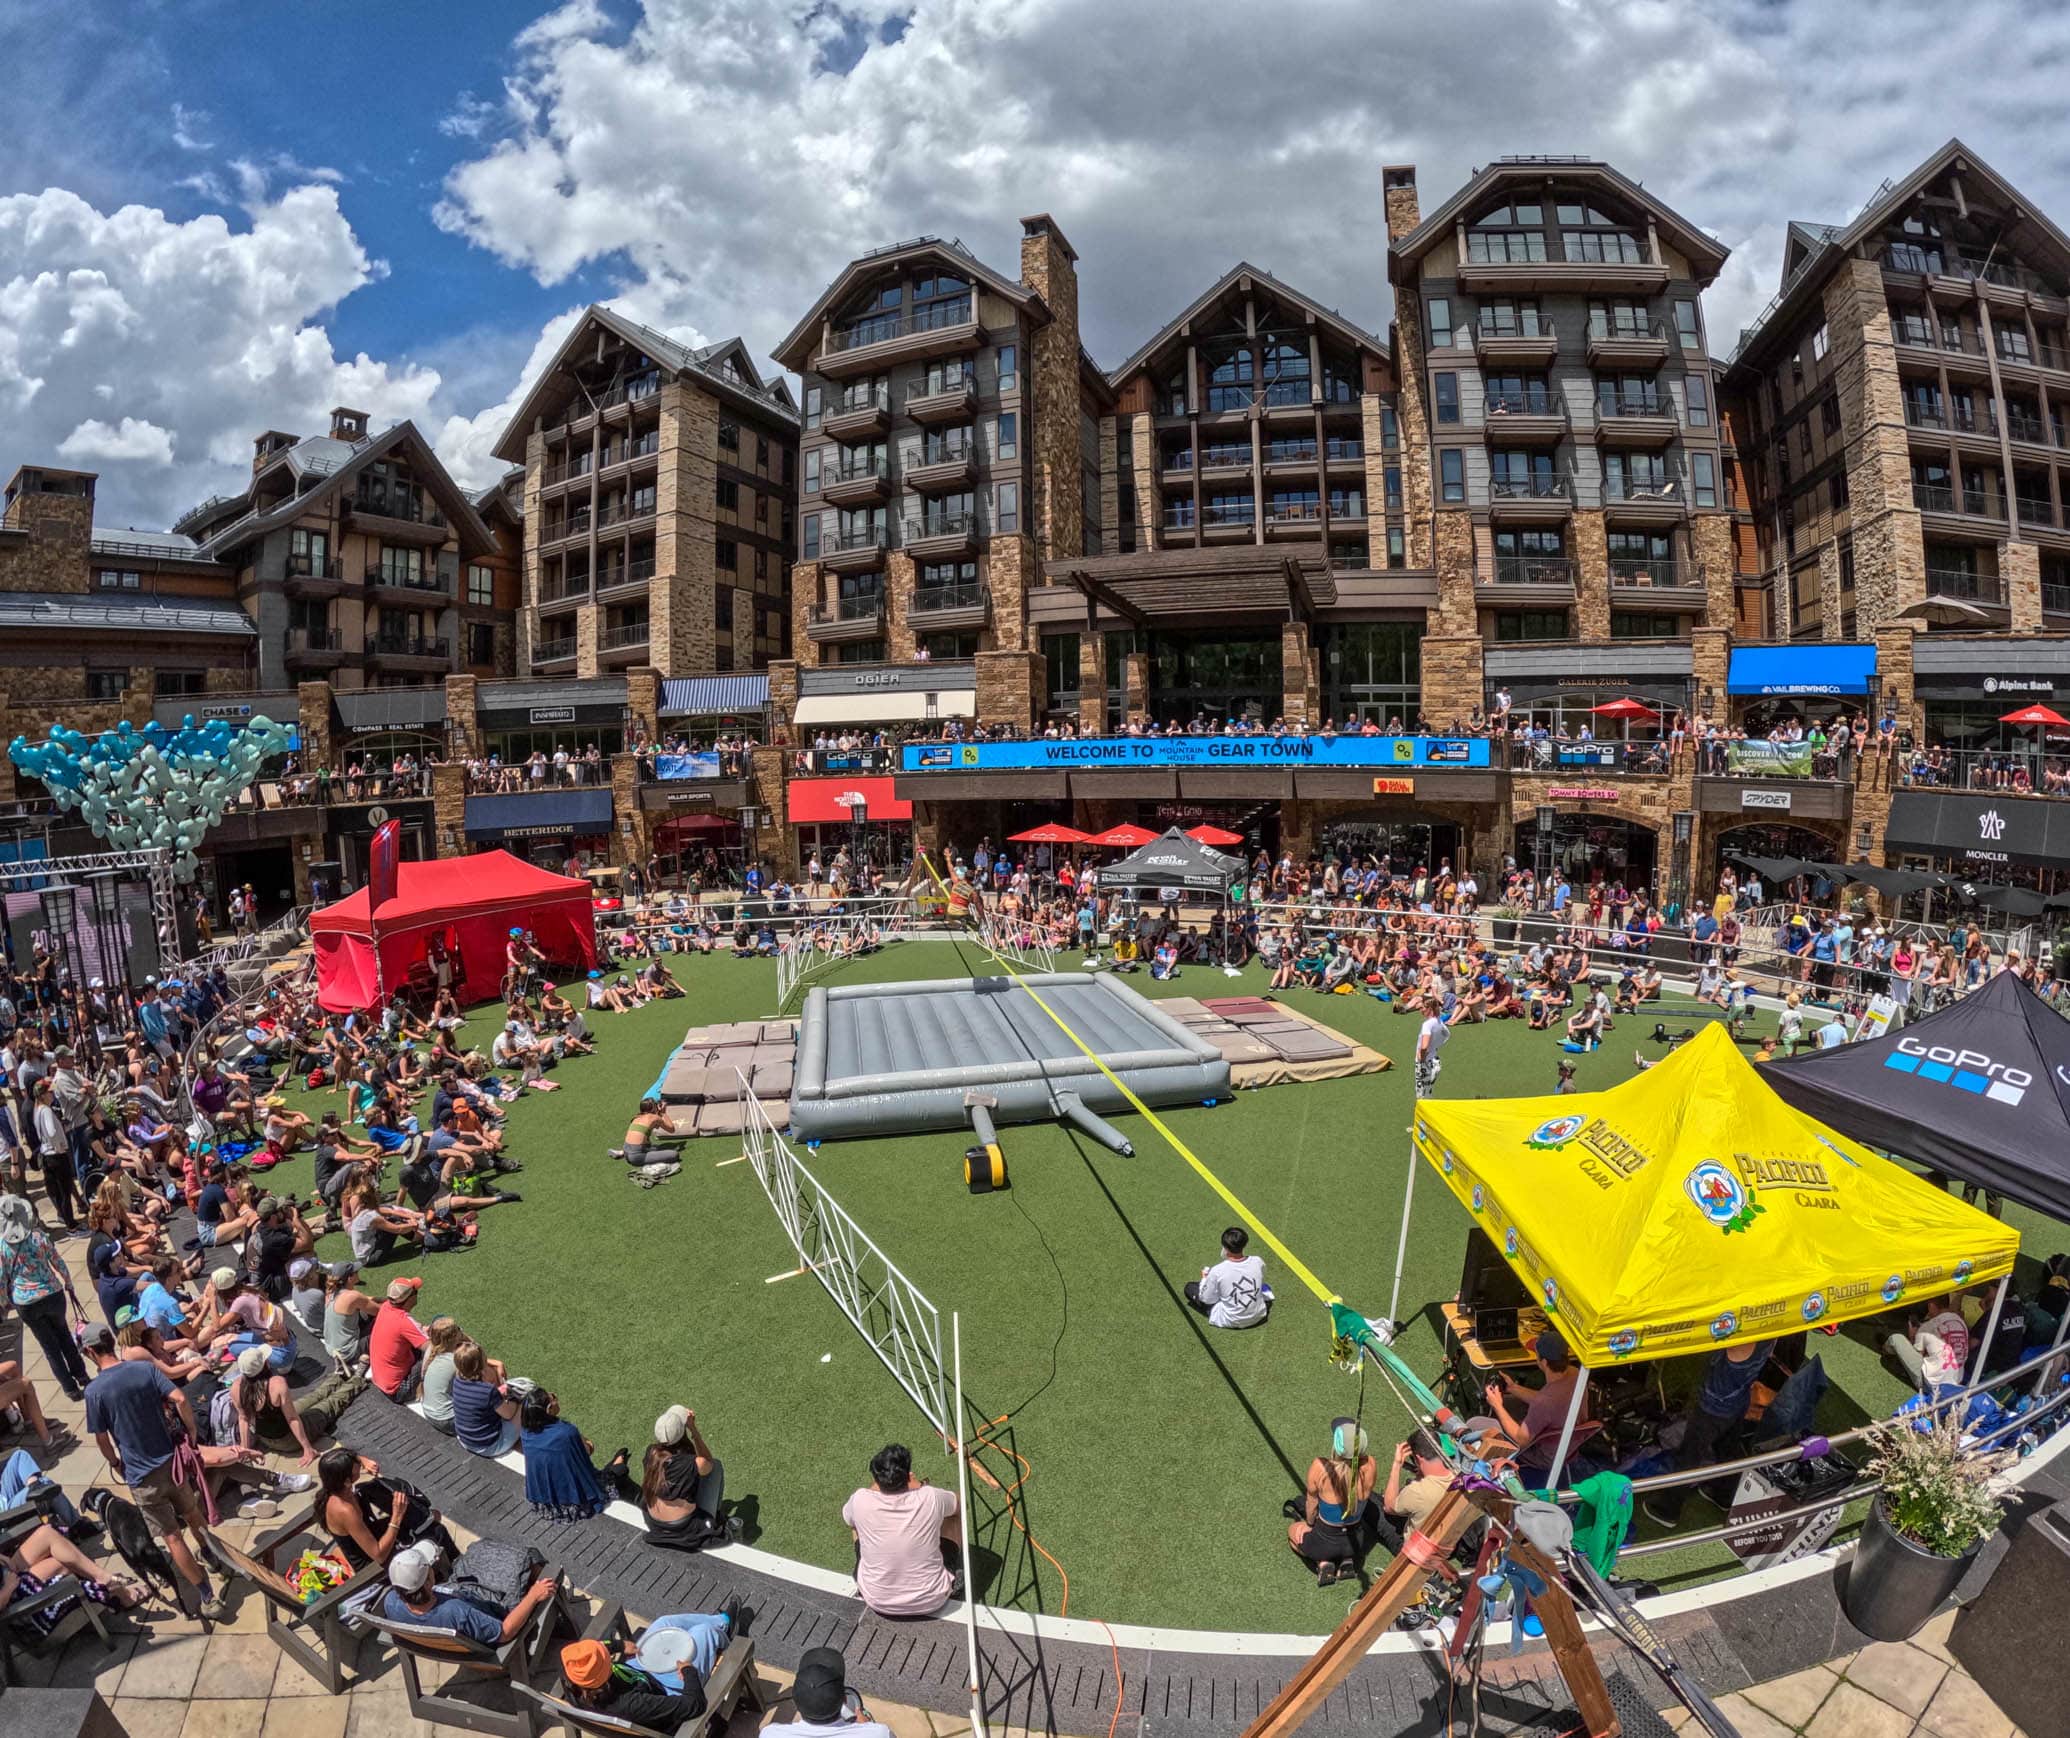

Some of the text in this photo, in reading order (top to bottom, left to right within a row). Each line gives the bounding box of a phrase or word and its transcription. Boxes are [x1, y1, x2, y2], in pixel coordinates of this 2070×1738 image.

[1789, 685, 1828, 694] BREWING
[1998, 680, 2054, 692] Alpine Bank
[203, 707, 240, 717] CHASE
[684, 706, 740, 716] GREY SALT
[826, 750, 873, 761] GoPro
[1046, 743, 1314, 759] WELCOME TO GEAR TOWN
[1159, 746, 1204, 755] MOUNTAIN
[1560, 744, 1615, 755] GoPro
[1166, 754, 1196, 762] HOUSE
[1550, 789, 1577, 797] TOMMY
[1577, 790, 1606, 798] BOWERS
[1744, 793, 1788, 805] SPYDER
[503, 825, 575, 837] BETTERIDGE
[1965, 849, 2009, 862] MONCLER
[1896, 1036, 2034, 1088] GoPro
[1579, 1158, 1615, 1191] CLARA
[1794, 1191, 1841, 1210] CLARA
[1733, 1532, 1783, 1547] BEFORE YOU TOSS
[1624, 1614, 1657, 1655] GIBBON
